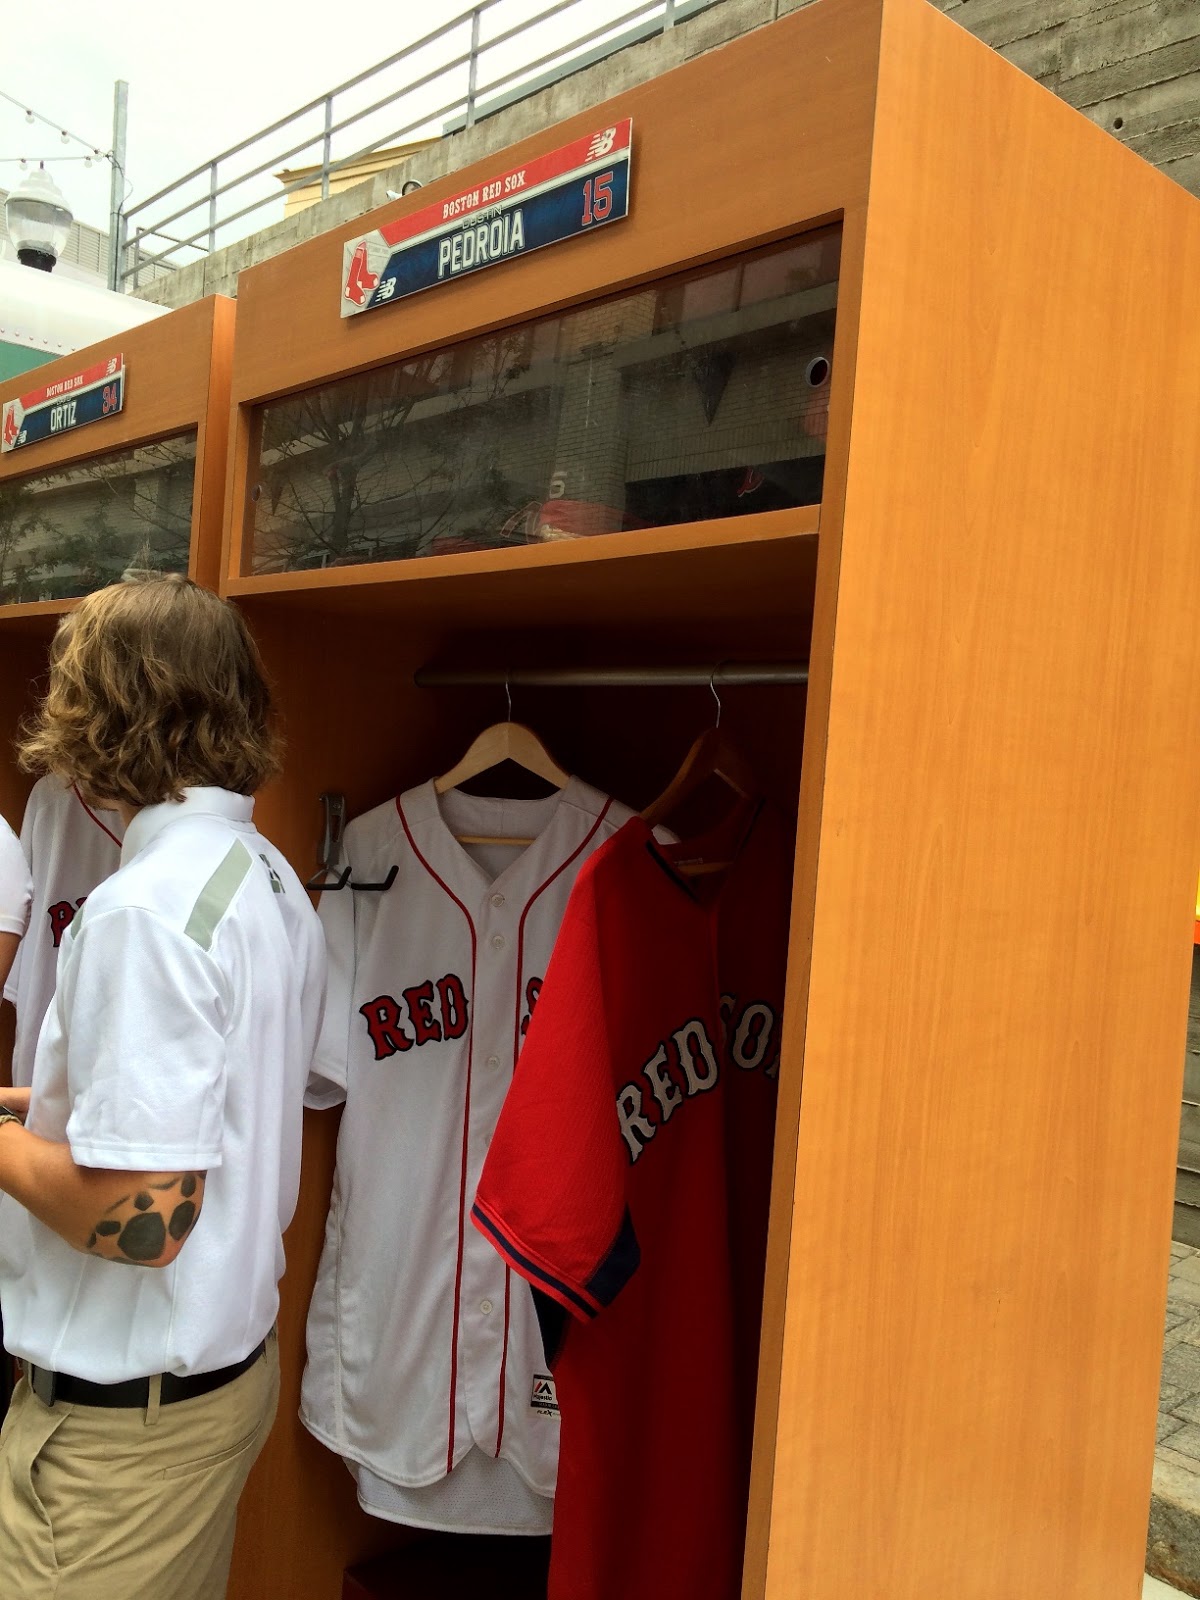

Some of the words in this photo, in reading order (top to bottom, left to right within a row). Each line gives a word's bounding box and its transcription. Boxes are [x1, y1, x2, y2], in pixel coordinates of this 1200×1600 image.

[443, 190, 480, 219] BOSTON
[482, 181, 502, 202] RED
[505, 170, 526, 193] SOX
[582, 171, 614, 226] 15
[438, 209, 525, 279] PEDROIA
[50, 401, 77, 432] ORTIZ
[359, 973, 470, 1061] RED
[615, 1019, 719, 1163] RED
